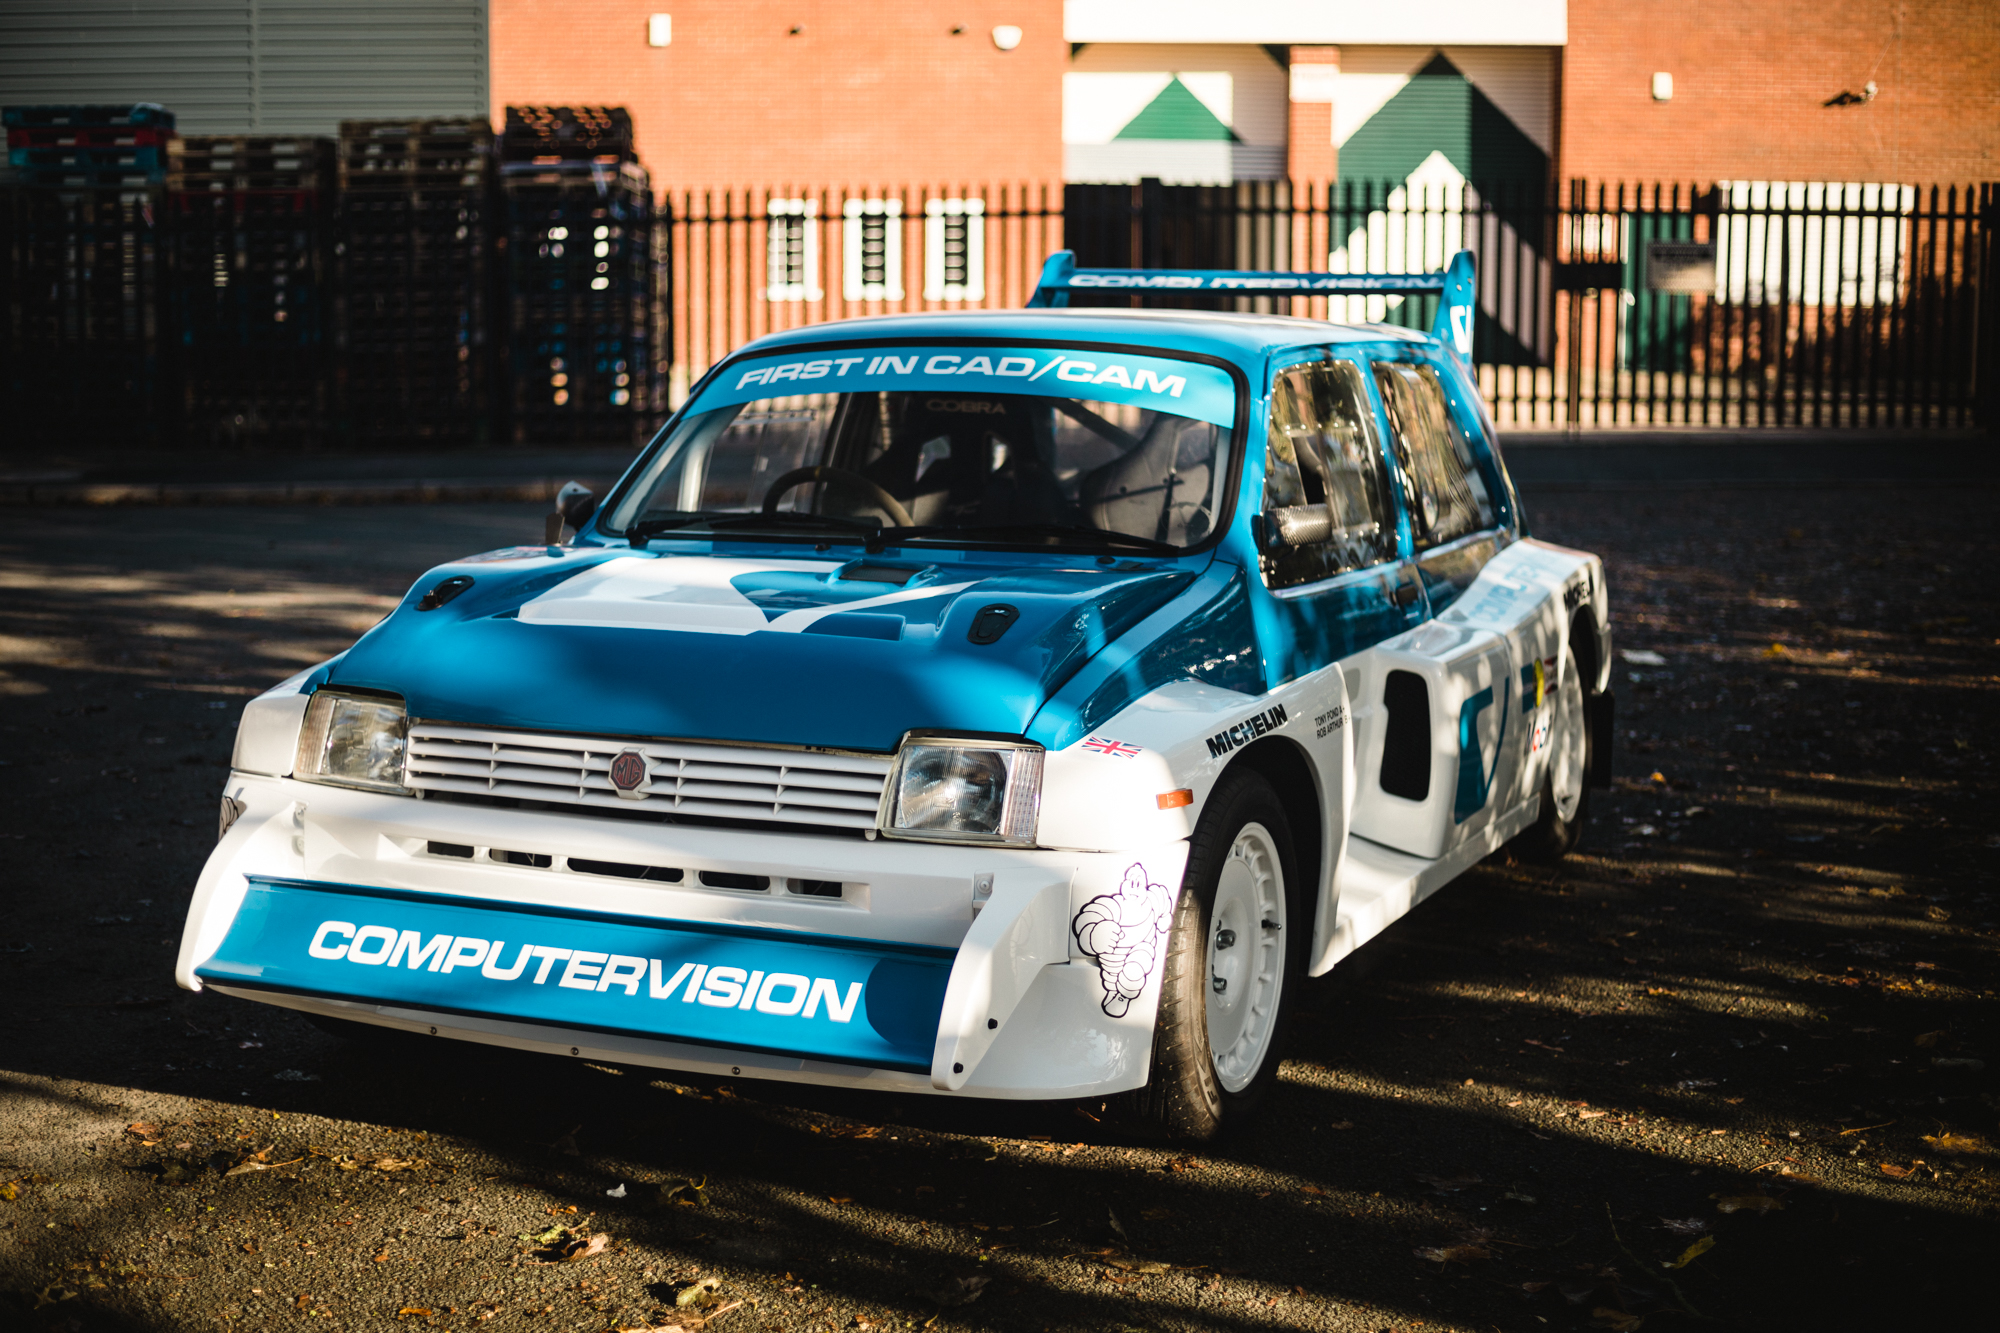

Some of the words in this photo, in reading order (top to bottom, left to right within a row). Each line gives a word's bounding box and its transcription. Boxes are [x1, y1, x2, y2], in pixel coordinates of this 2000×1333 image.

[735, 357, 865, 390] FIRST
[865, 356, 920, 375] IN
[924, 355, 1187, 398] CAD/CAM
[926, 399, 1006, 414] COBRA
[1314, 713, 1327, 727] TONY
[1326, 706, 1339, 721] POND
[1316, 726, 1327, 739] ROB
[1327, 717, 1343, 735] ARTHUR
[1206, 703, 1288, 759] MICHELIN
[616, 757, 641, 785] MG
[308, 920, 864, 1024] COMPUTERVISION
